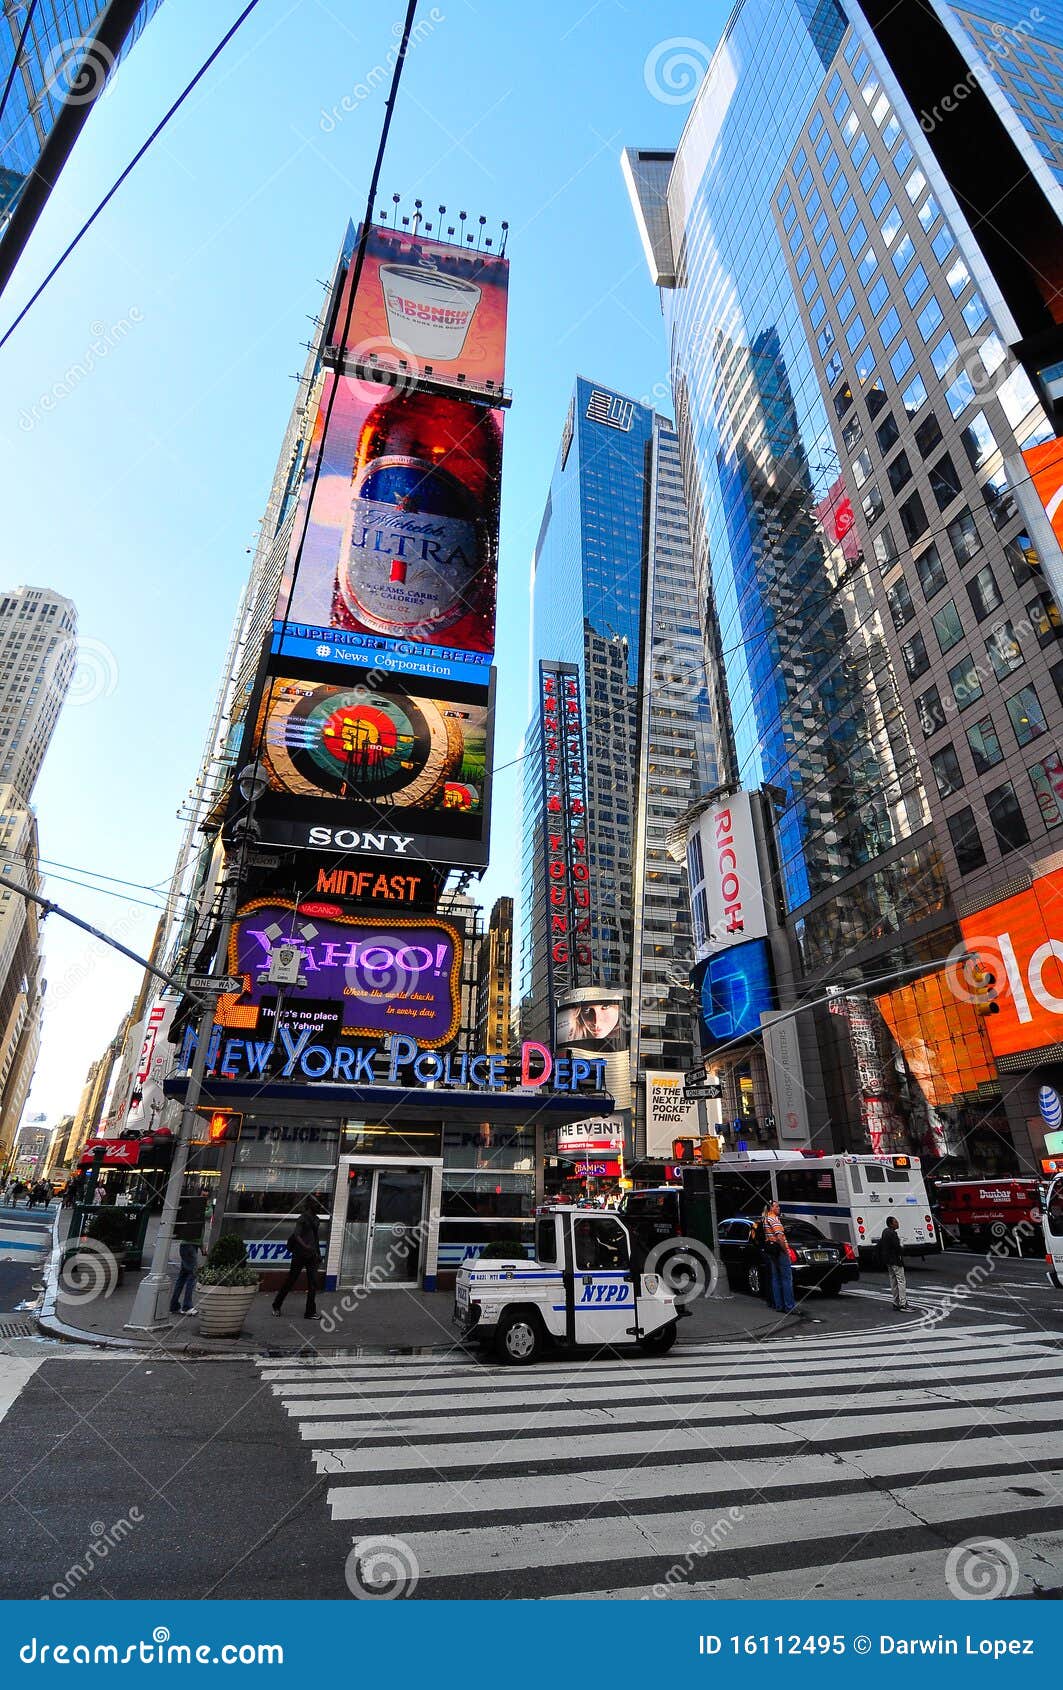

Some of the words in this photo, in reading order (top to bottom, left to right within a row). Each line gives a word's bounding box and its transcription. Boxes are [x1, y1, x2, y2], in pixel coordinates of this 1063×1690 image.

[404, 308, 467, 325] DONUTS
[352, 527, 471, 567] ULTRA
[285, 625, 378, 648] SUPERIOR
[383, 640, 438, 657] LIGHT
[442, 650, 485, 665] BEER
[334, 648, 369, 663] News
[375, 654, 451, 676] Corporation
[308, 827, 415, 853] SONY
[714, 808, 744, 934] RICOH
[549, 834, 569, 963] YOUNG
[302, 905, 339, 915] VACANCY
[194, 979, 211, 987] ONE
[218, 979, 236, 989] WAY
[410, 992, 435, 1001] checks
[262, 1007, 298, 1018] Thre's
[300, 1011, 312, 1019] no
[313, 1012, 339, 1021] place
[397, 1008, 418, 1017] every
[293, 1021, 324, 1031] Yahoo!
[177, 1025, 275, 1075] NEW
[279, 1027, 377, 1083] YORK
[388, 1034, 506, 1087] POLICE
[521, 1040, 608, 1090] DEPT
[652, 1078, 679, 1088] FIRST
[652, 1087, 661, 1095] IS
[663, 1087, 681, 1096] THE
[652, 1096, 679, 1104] NEXT
[680, 1097, 695, 1105] BIG
[652, 1105, 691, 1113] POCKET
[653, 1113, 683, 1122] THING.
[258, 1125, 320, 1142] POLICE
[980, 1188, 1011, 1199] Dunbar
[581, 1285, 630, 1303] NYPD
